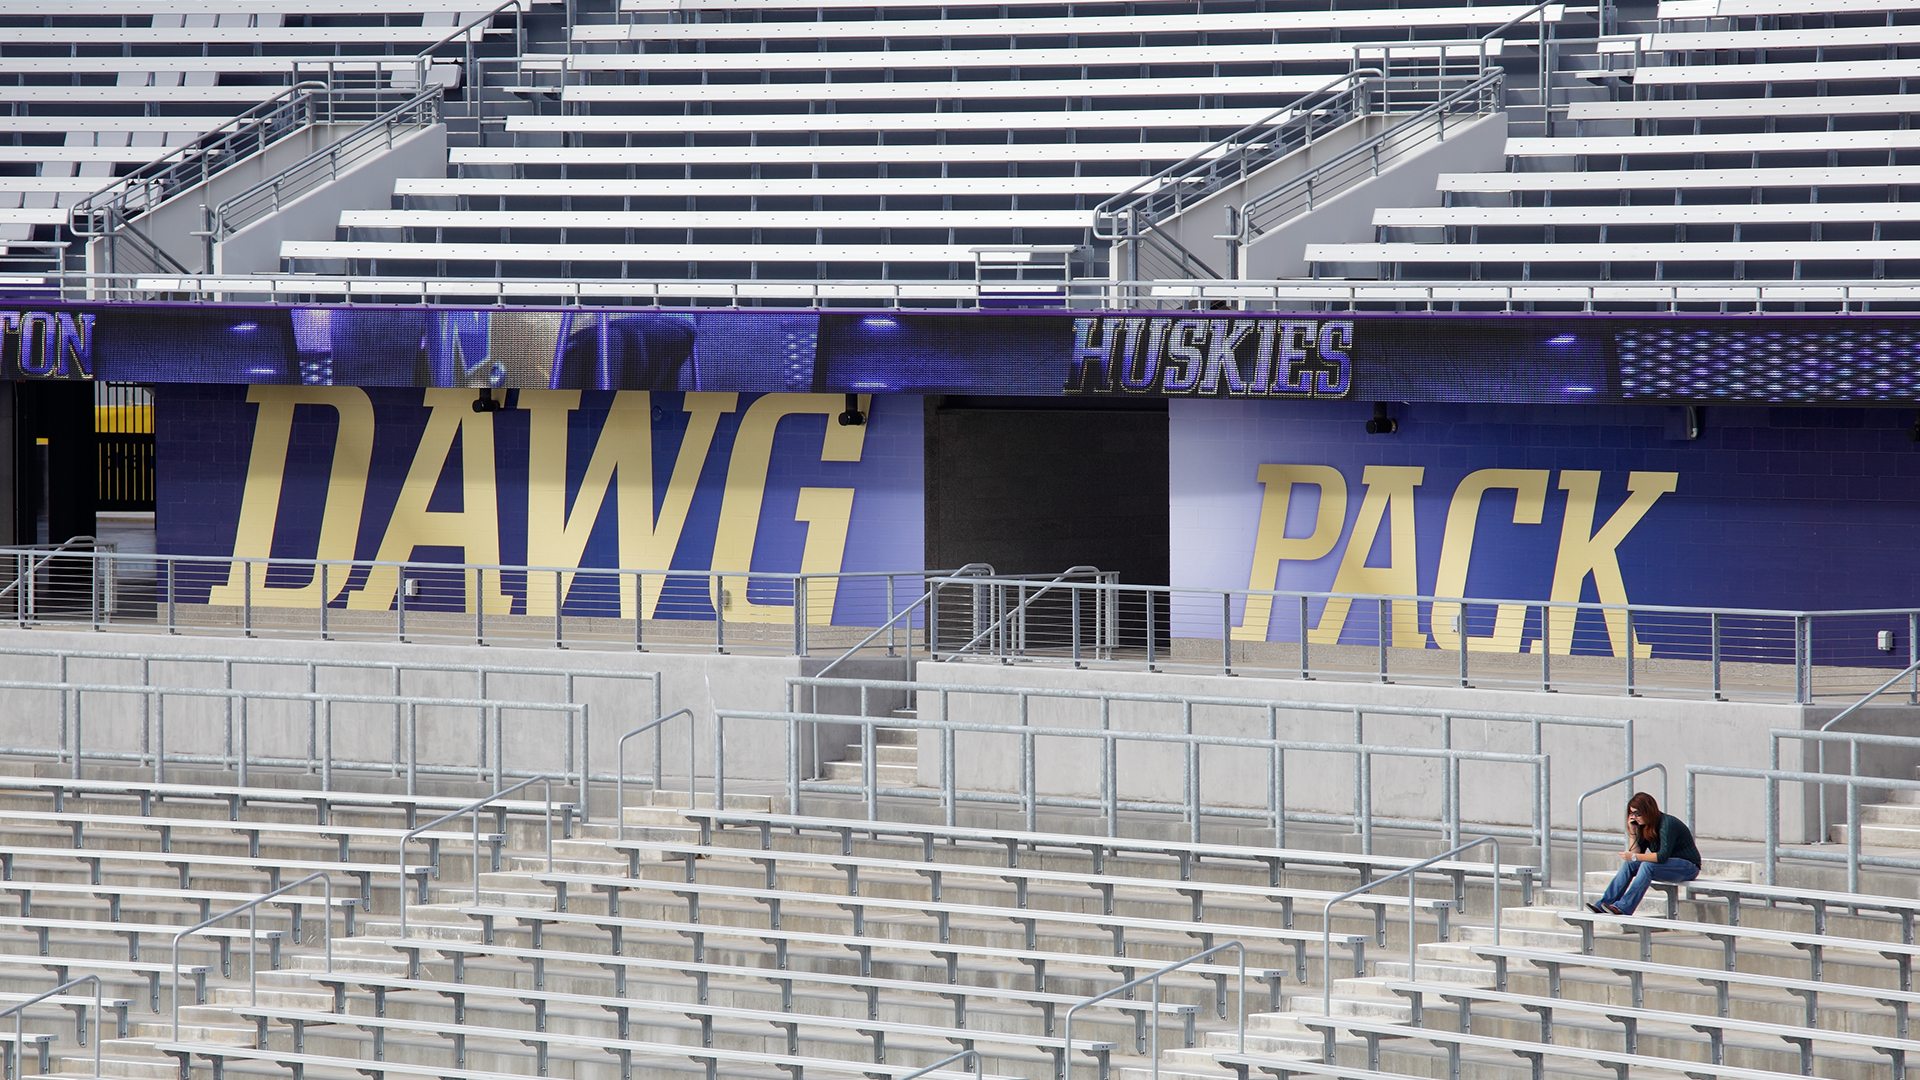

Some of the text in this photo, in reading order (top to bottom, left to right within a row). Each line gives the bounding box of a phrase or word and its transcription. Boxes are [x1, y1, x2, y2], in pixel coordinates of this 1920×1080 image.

[1063, 318, 1354, 398] HUSKIES
[209, 384, 872, 626] DAWG
[1229, 463, 1679, 659] PACK
